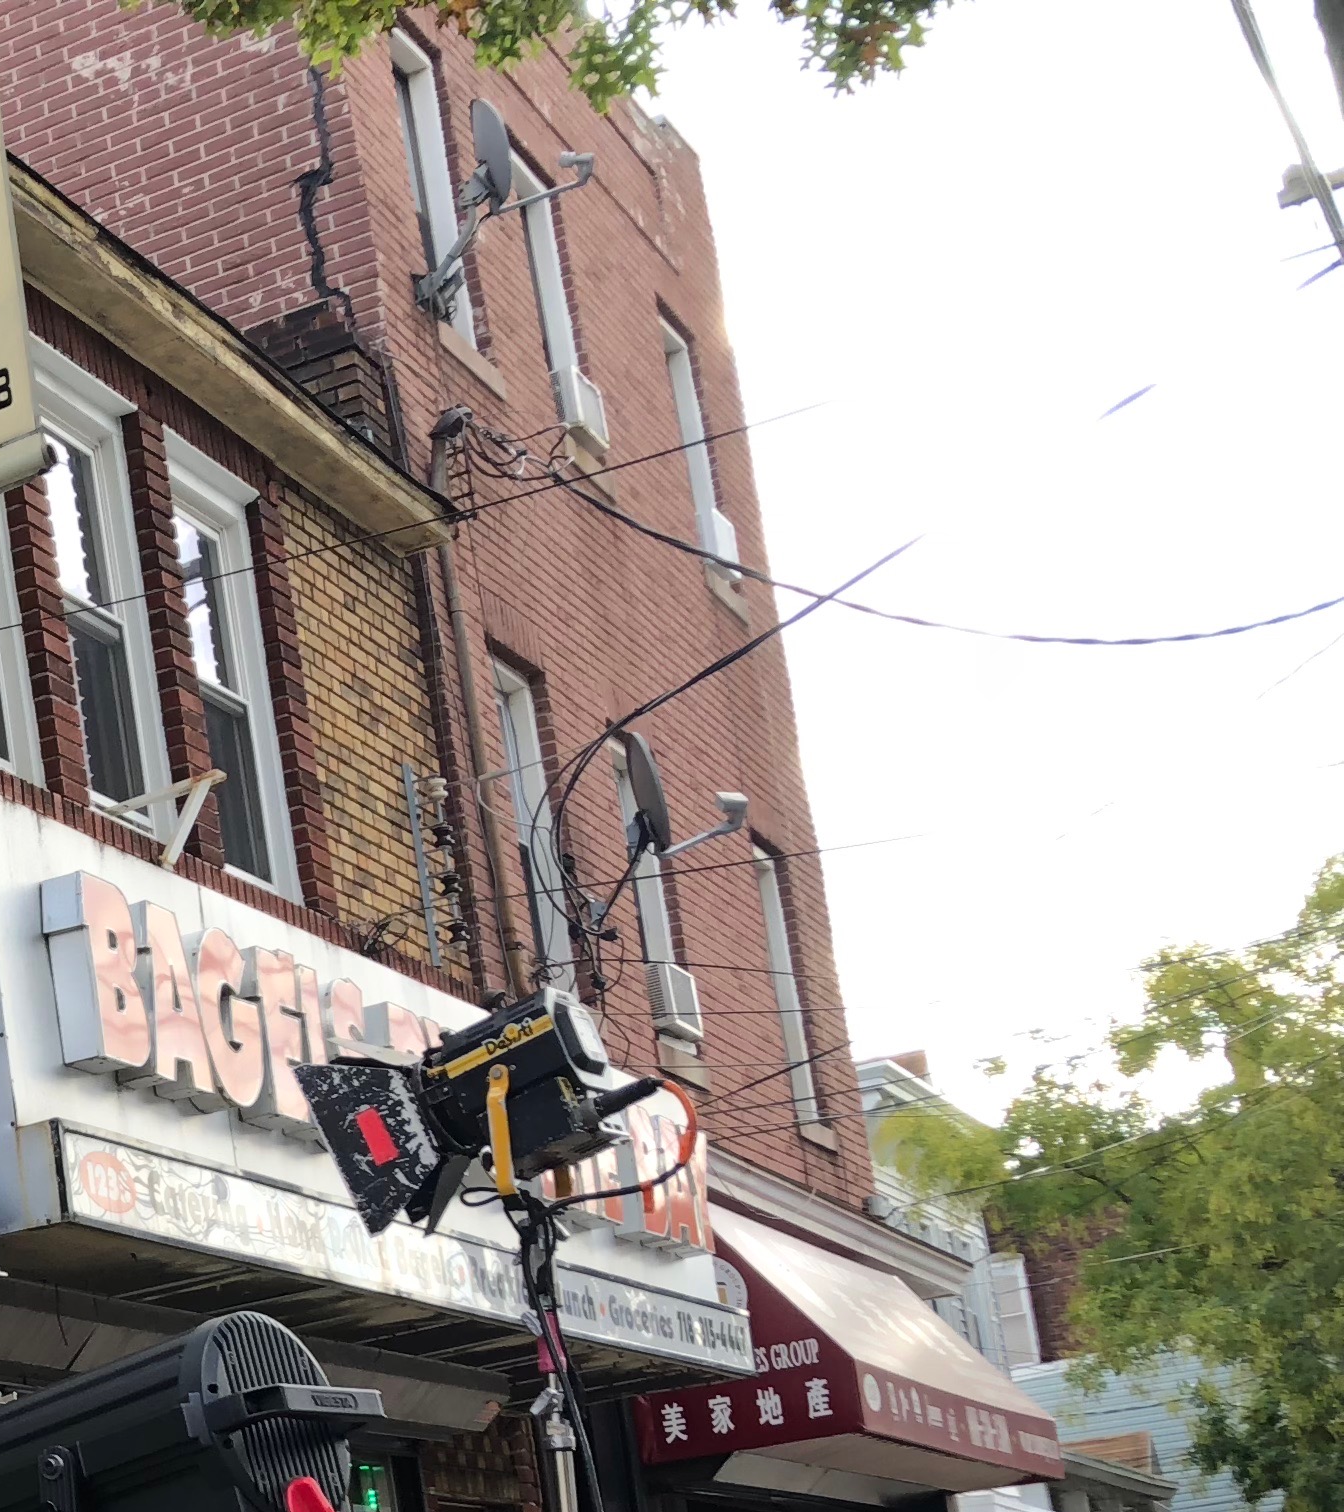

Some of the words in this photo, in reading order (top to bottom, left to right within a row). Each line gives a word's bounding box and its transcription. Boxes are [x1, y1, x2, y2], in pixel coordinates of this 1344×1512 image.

[558, 1284, 598, 1322] unch
[609, 1300, 675, 1341] Groceries
[770, 1337, 820, 1371] GROUP
[660, 1377, 834, 1444] 美家地產
